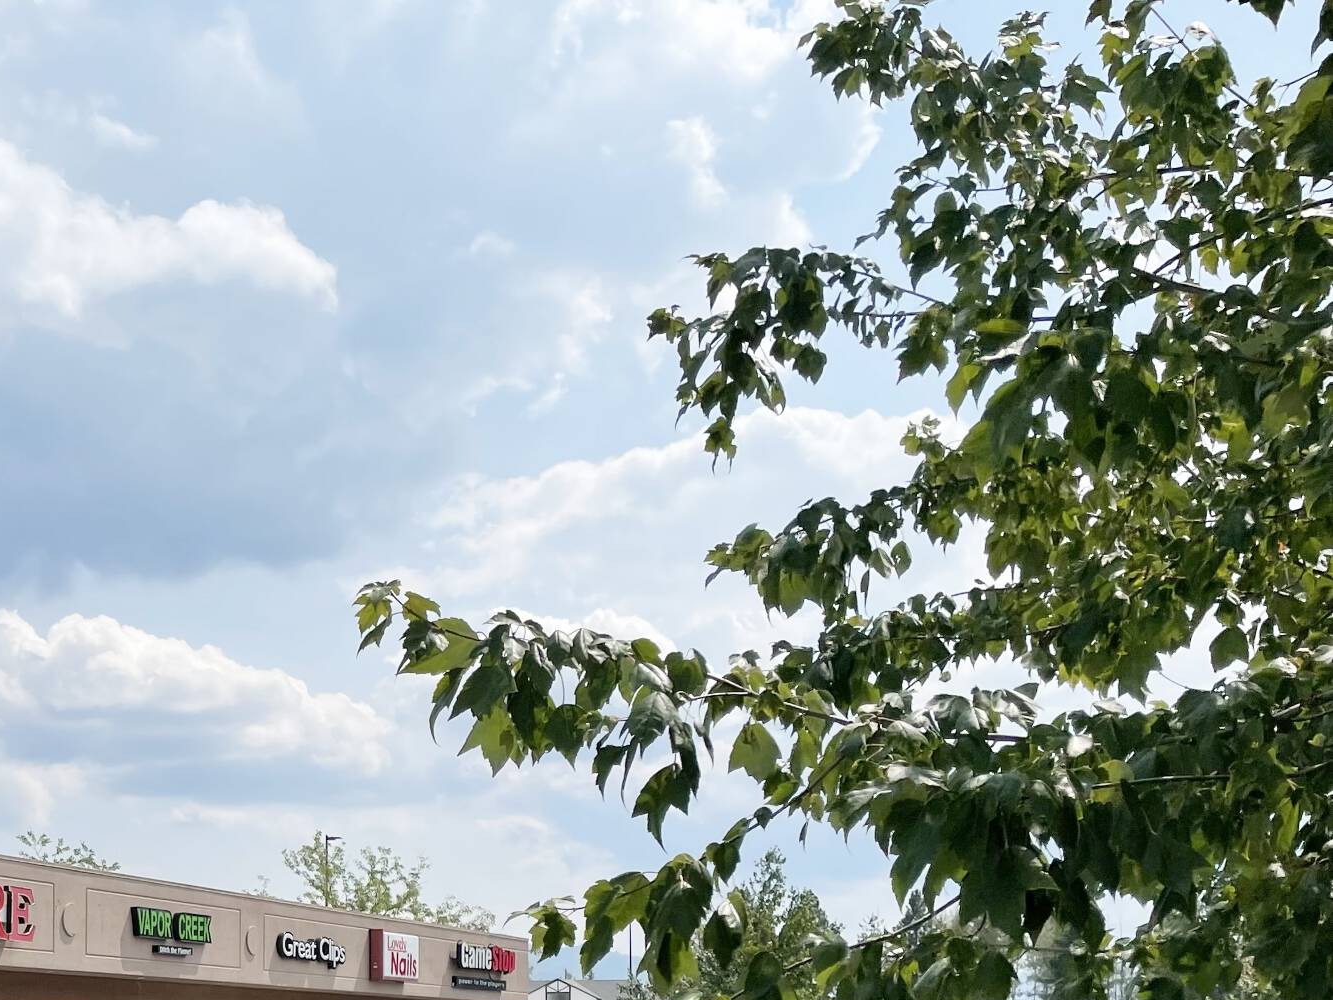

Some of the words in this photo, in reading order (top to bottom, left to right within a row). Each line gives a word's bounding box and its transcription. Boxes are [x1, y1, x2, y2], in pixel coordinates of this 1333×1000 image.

[137, 908, 172, 938] VAPOR
[178, 914, 211, 942] CREEK
[282, 932, 316, 961] Great
[320, 938, 346, 967] Clips
[391, 952, 417, 976] Nails
[461, 942, 516, 974] GameStop
